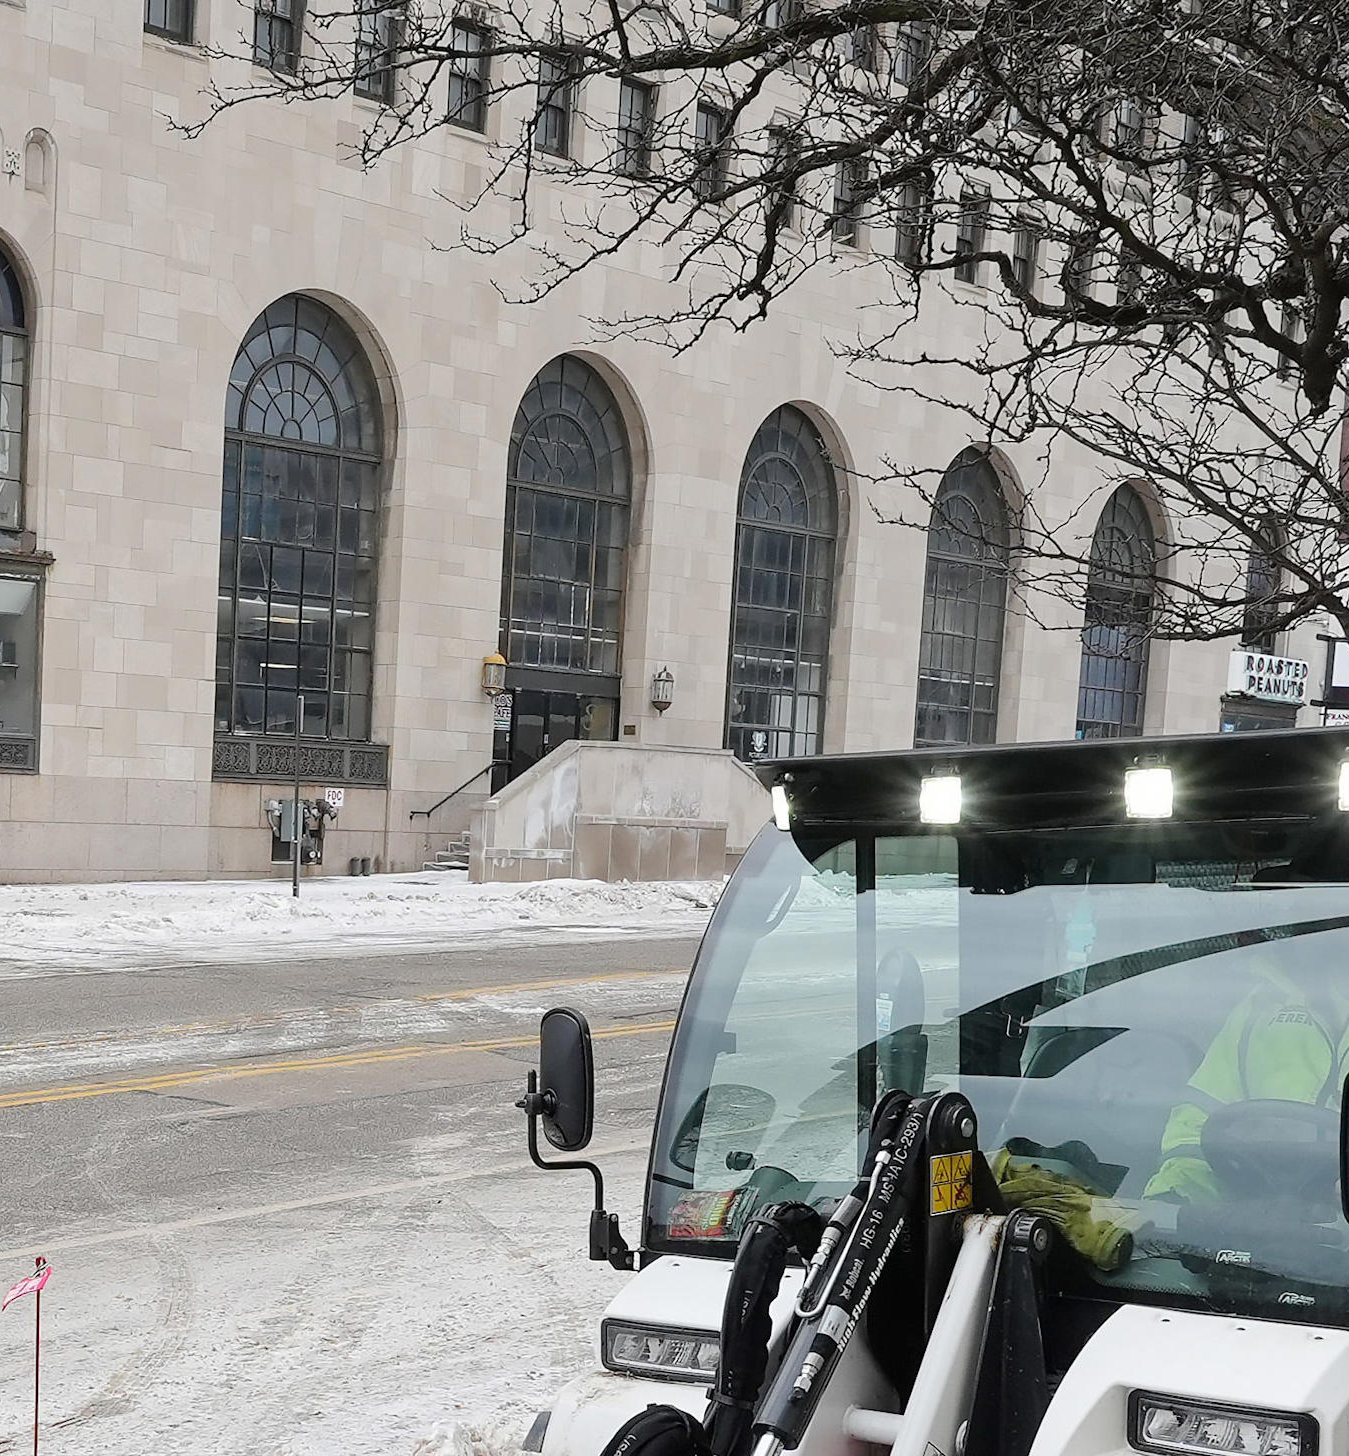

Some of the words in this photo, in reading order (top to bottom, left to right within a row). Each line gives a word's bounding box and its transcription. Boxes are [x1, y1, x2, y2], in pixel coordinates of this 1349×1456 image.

[1246, 656, 1309, 679] ROASTED
[1247, 676, 1305, 697] PEANUTS
[327, 790, 343, 801] FDC
[860, 1209, 884, 1249] HG-16
[893, 1112, 924, 1165] IC-293/1
